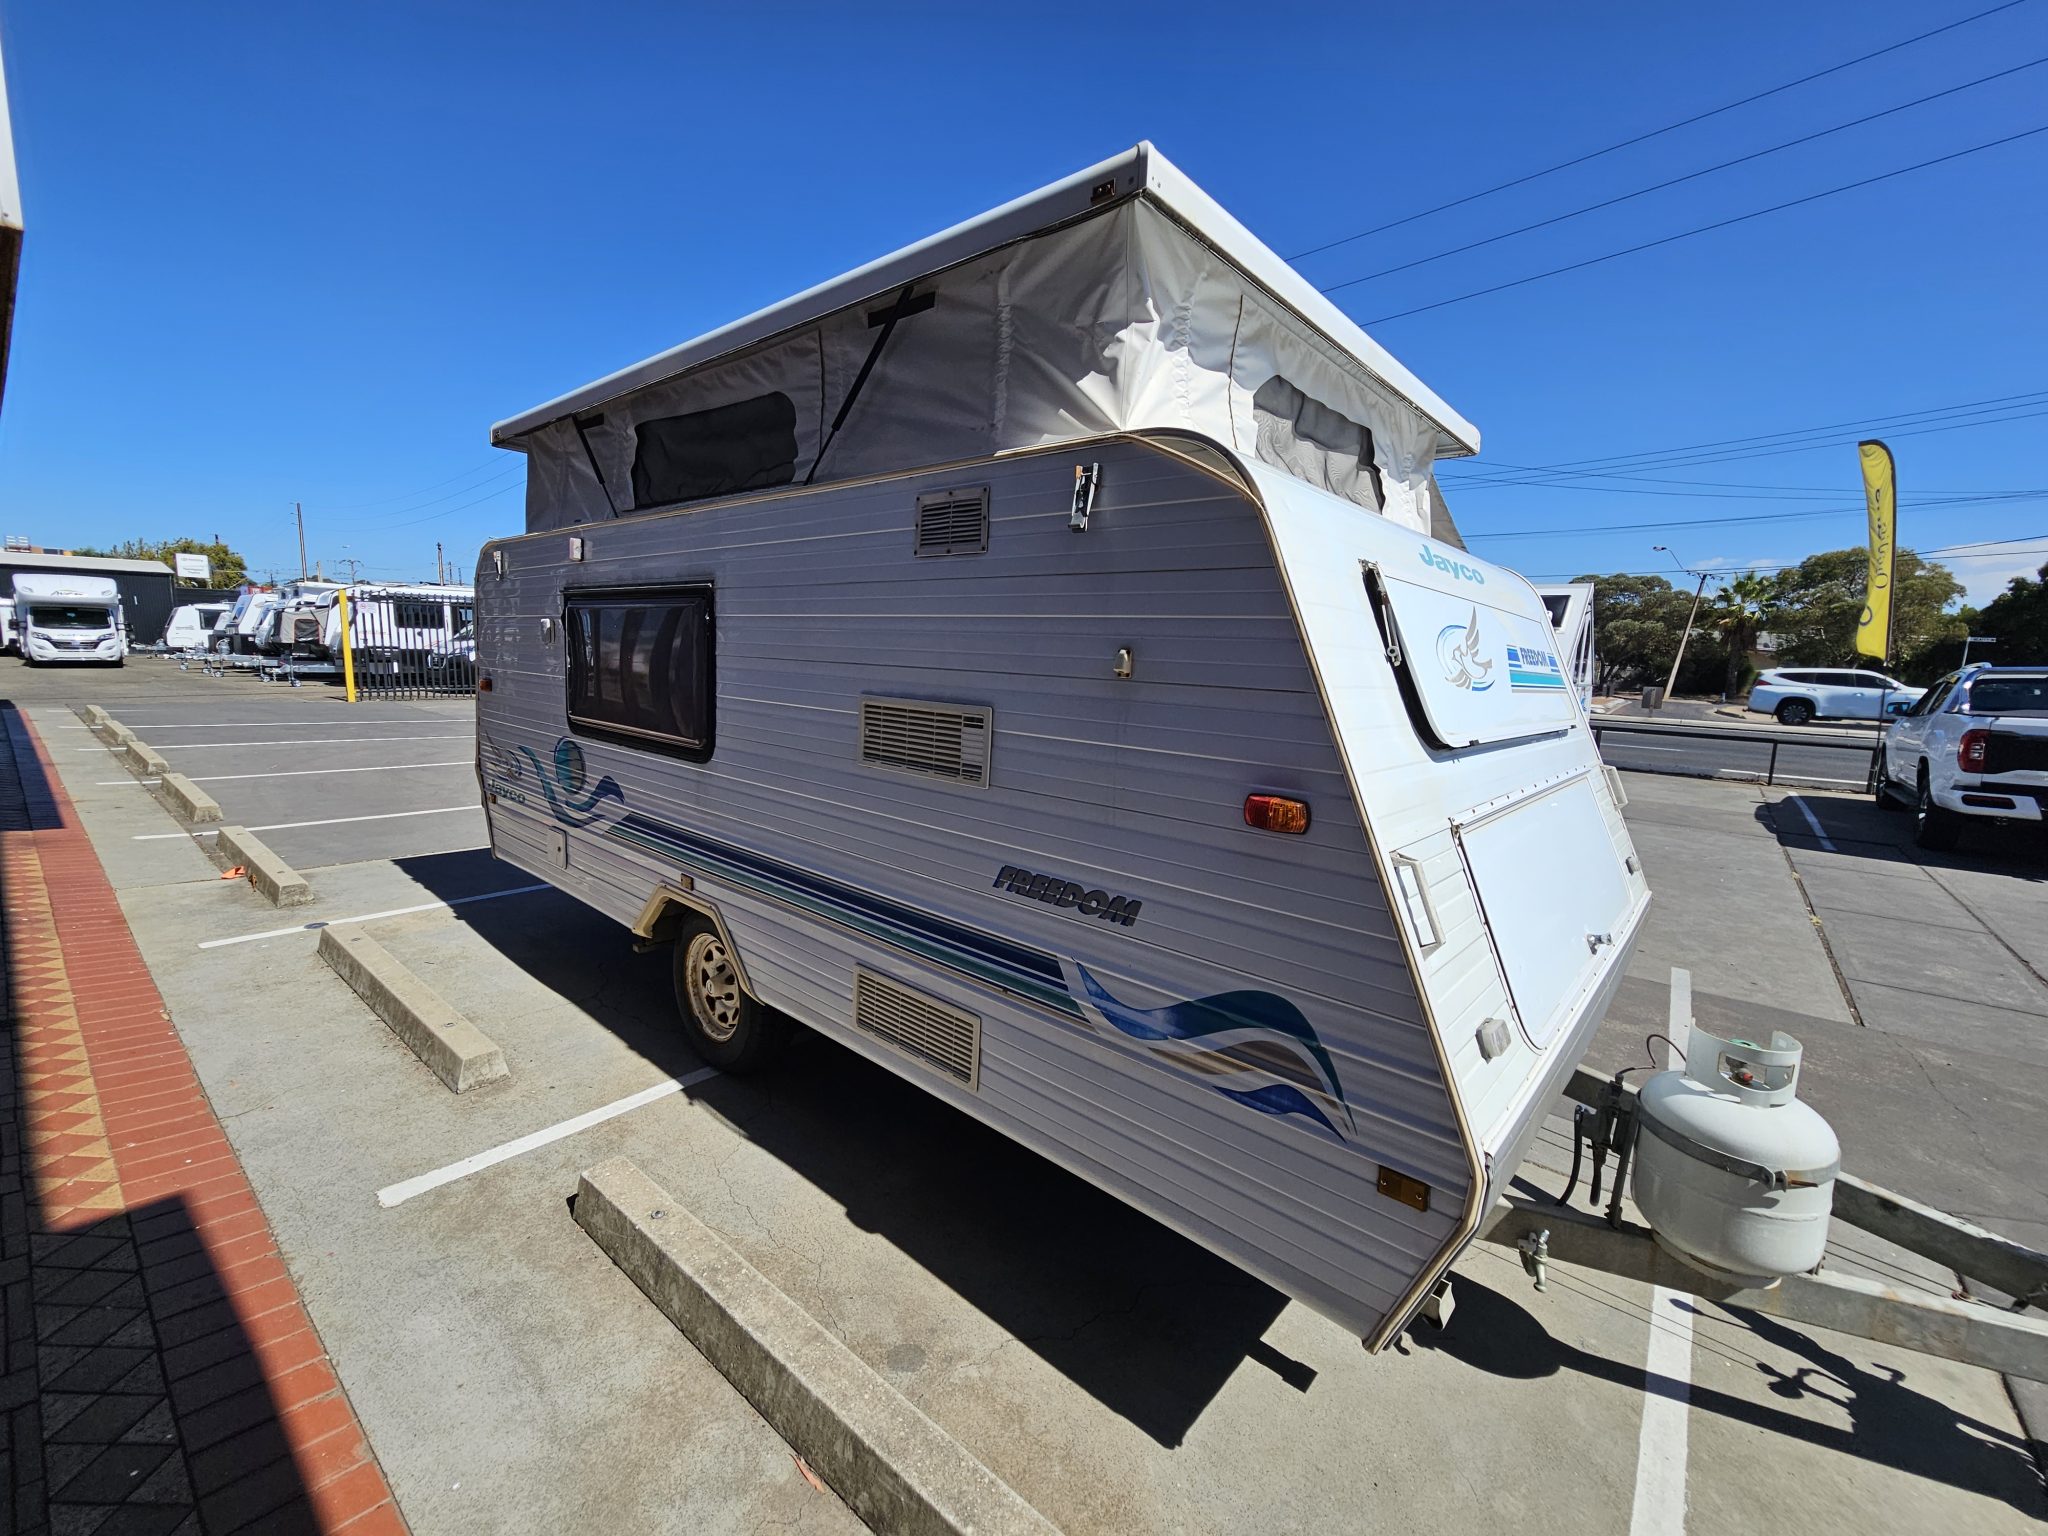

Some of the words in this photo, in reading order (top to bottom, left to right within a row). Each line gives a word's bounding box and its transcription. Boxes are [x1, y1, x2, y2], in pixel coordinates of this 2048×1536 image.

[1419, 544, 1485, 585] Jayco
[1519, 647, 1550, 668] FREEDOM
[487, 779, 526, 804] Jayco
[992, 864, 1143, 927] FREEDOM
